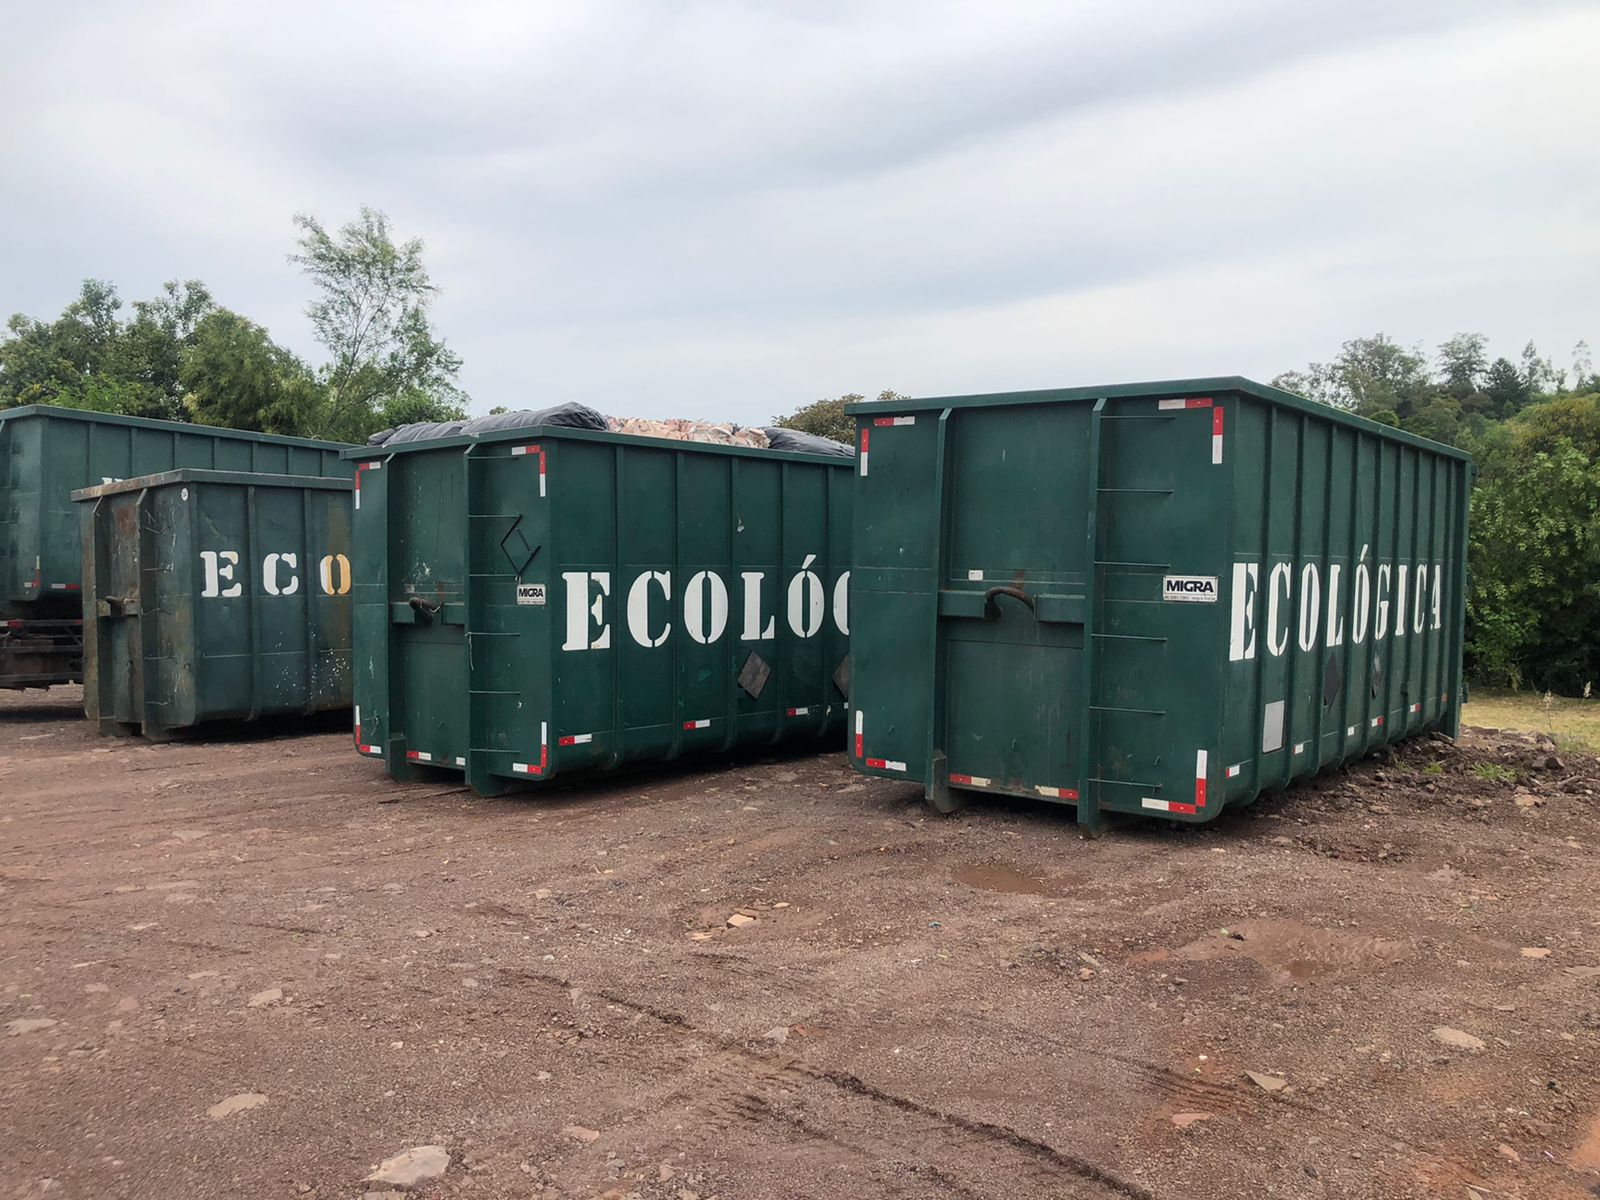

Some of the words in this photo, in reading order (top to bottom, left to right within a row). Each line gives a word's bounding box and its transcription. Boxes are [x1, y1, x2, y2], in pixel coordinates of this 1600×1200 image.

[518, 587, 544, 598] MIGRA
[1166, 579, 1214, 593] MIGRA
[1229, 544, 1441, 661] ECOLÓGICA
